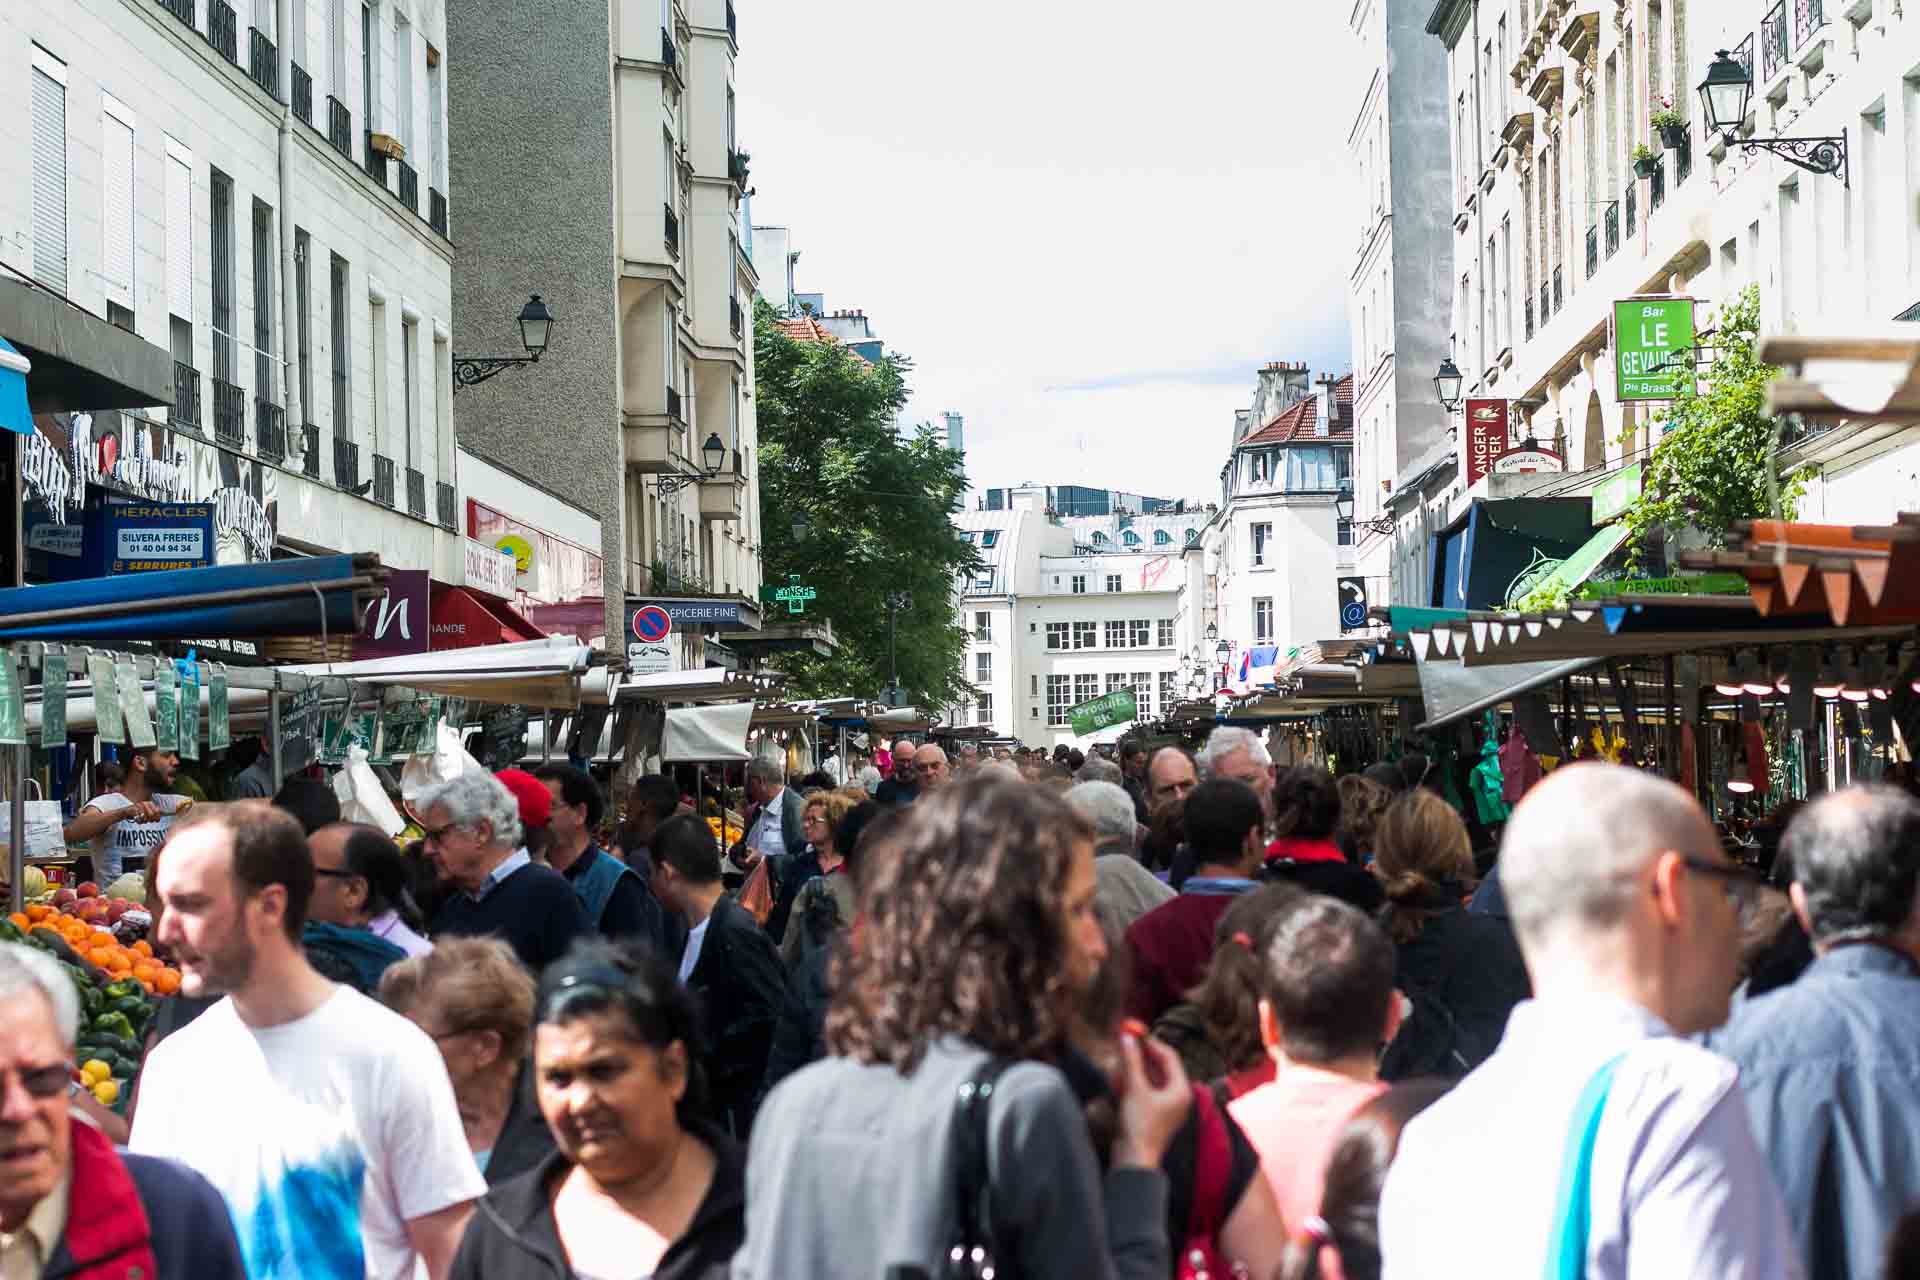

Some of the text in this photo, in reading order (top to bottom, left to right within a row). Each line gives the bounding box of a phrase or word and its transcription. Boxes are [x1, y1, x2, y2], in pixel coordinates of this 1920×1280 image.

[1642, 306, 1664, 317] Bar
[1641, 323, 1669, 347] LE
[115, 507, 208, 518] HERACLES
[122, 533, 200, 543] SILVERA FRERES
[130, 544, 191, 552] 01 40 04 94 34
[714, 607, 736, 617] FINE
[1094, 711, 1116, 727] BIO
